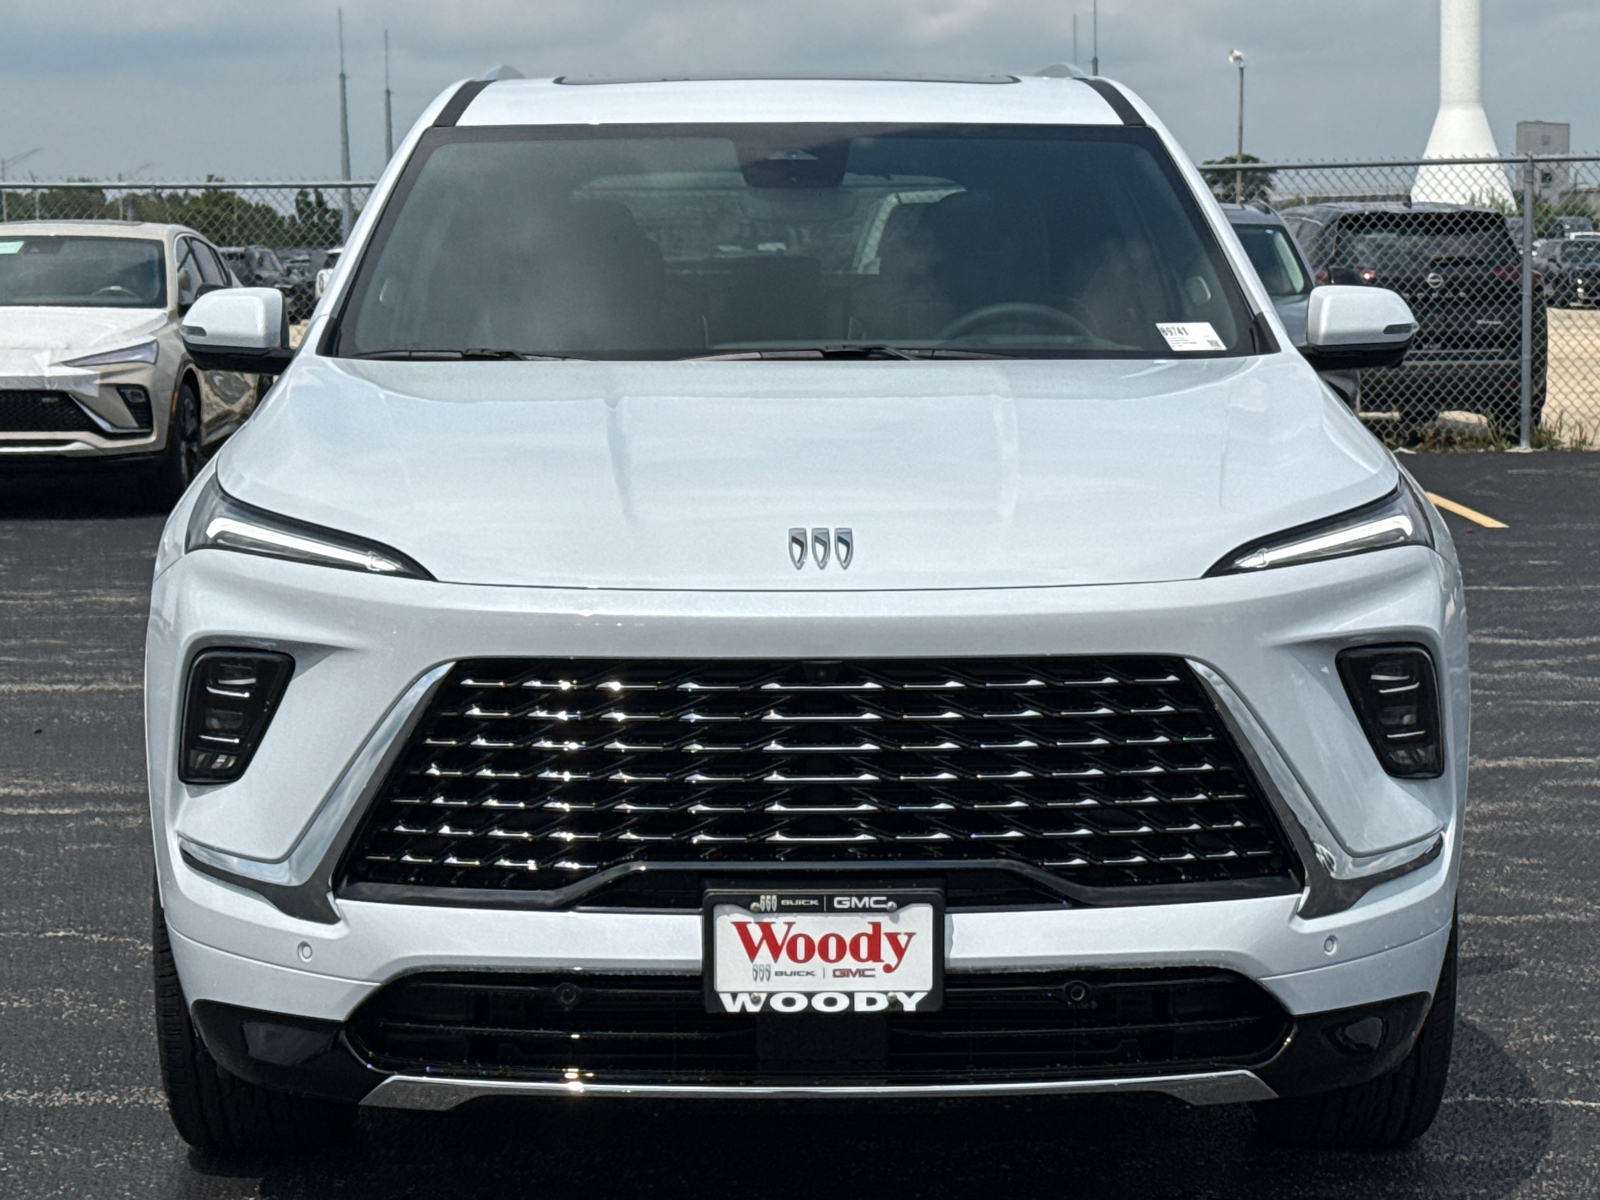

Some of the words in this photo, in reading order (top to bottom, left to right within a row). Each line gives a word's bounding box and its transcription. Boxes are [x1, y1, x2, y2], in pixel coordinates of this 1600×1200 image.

[833, 897, 888, 909] GMC
[731, 921, 916, 974] Woody
[832, 968, 876, 978] GMC
[719, 992, 928, 1012] WOODY
